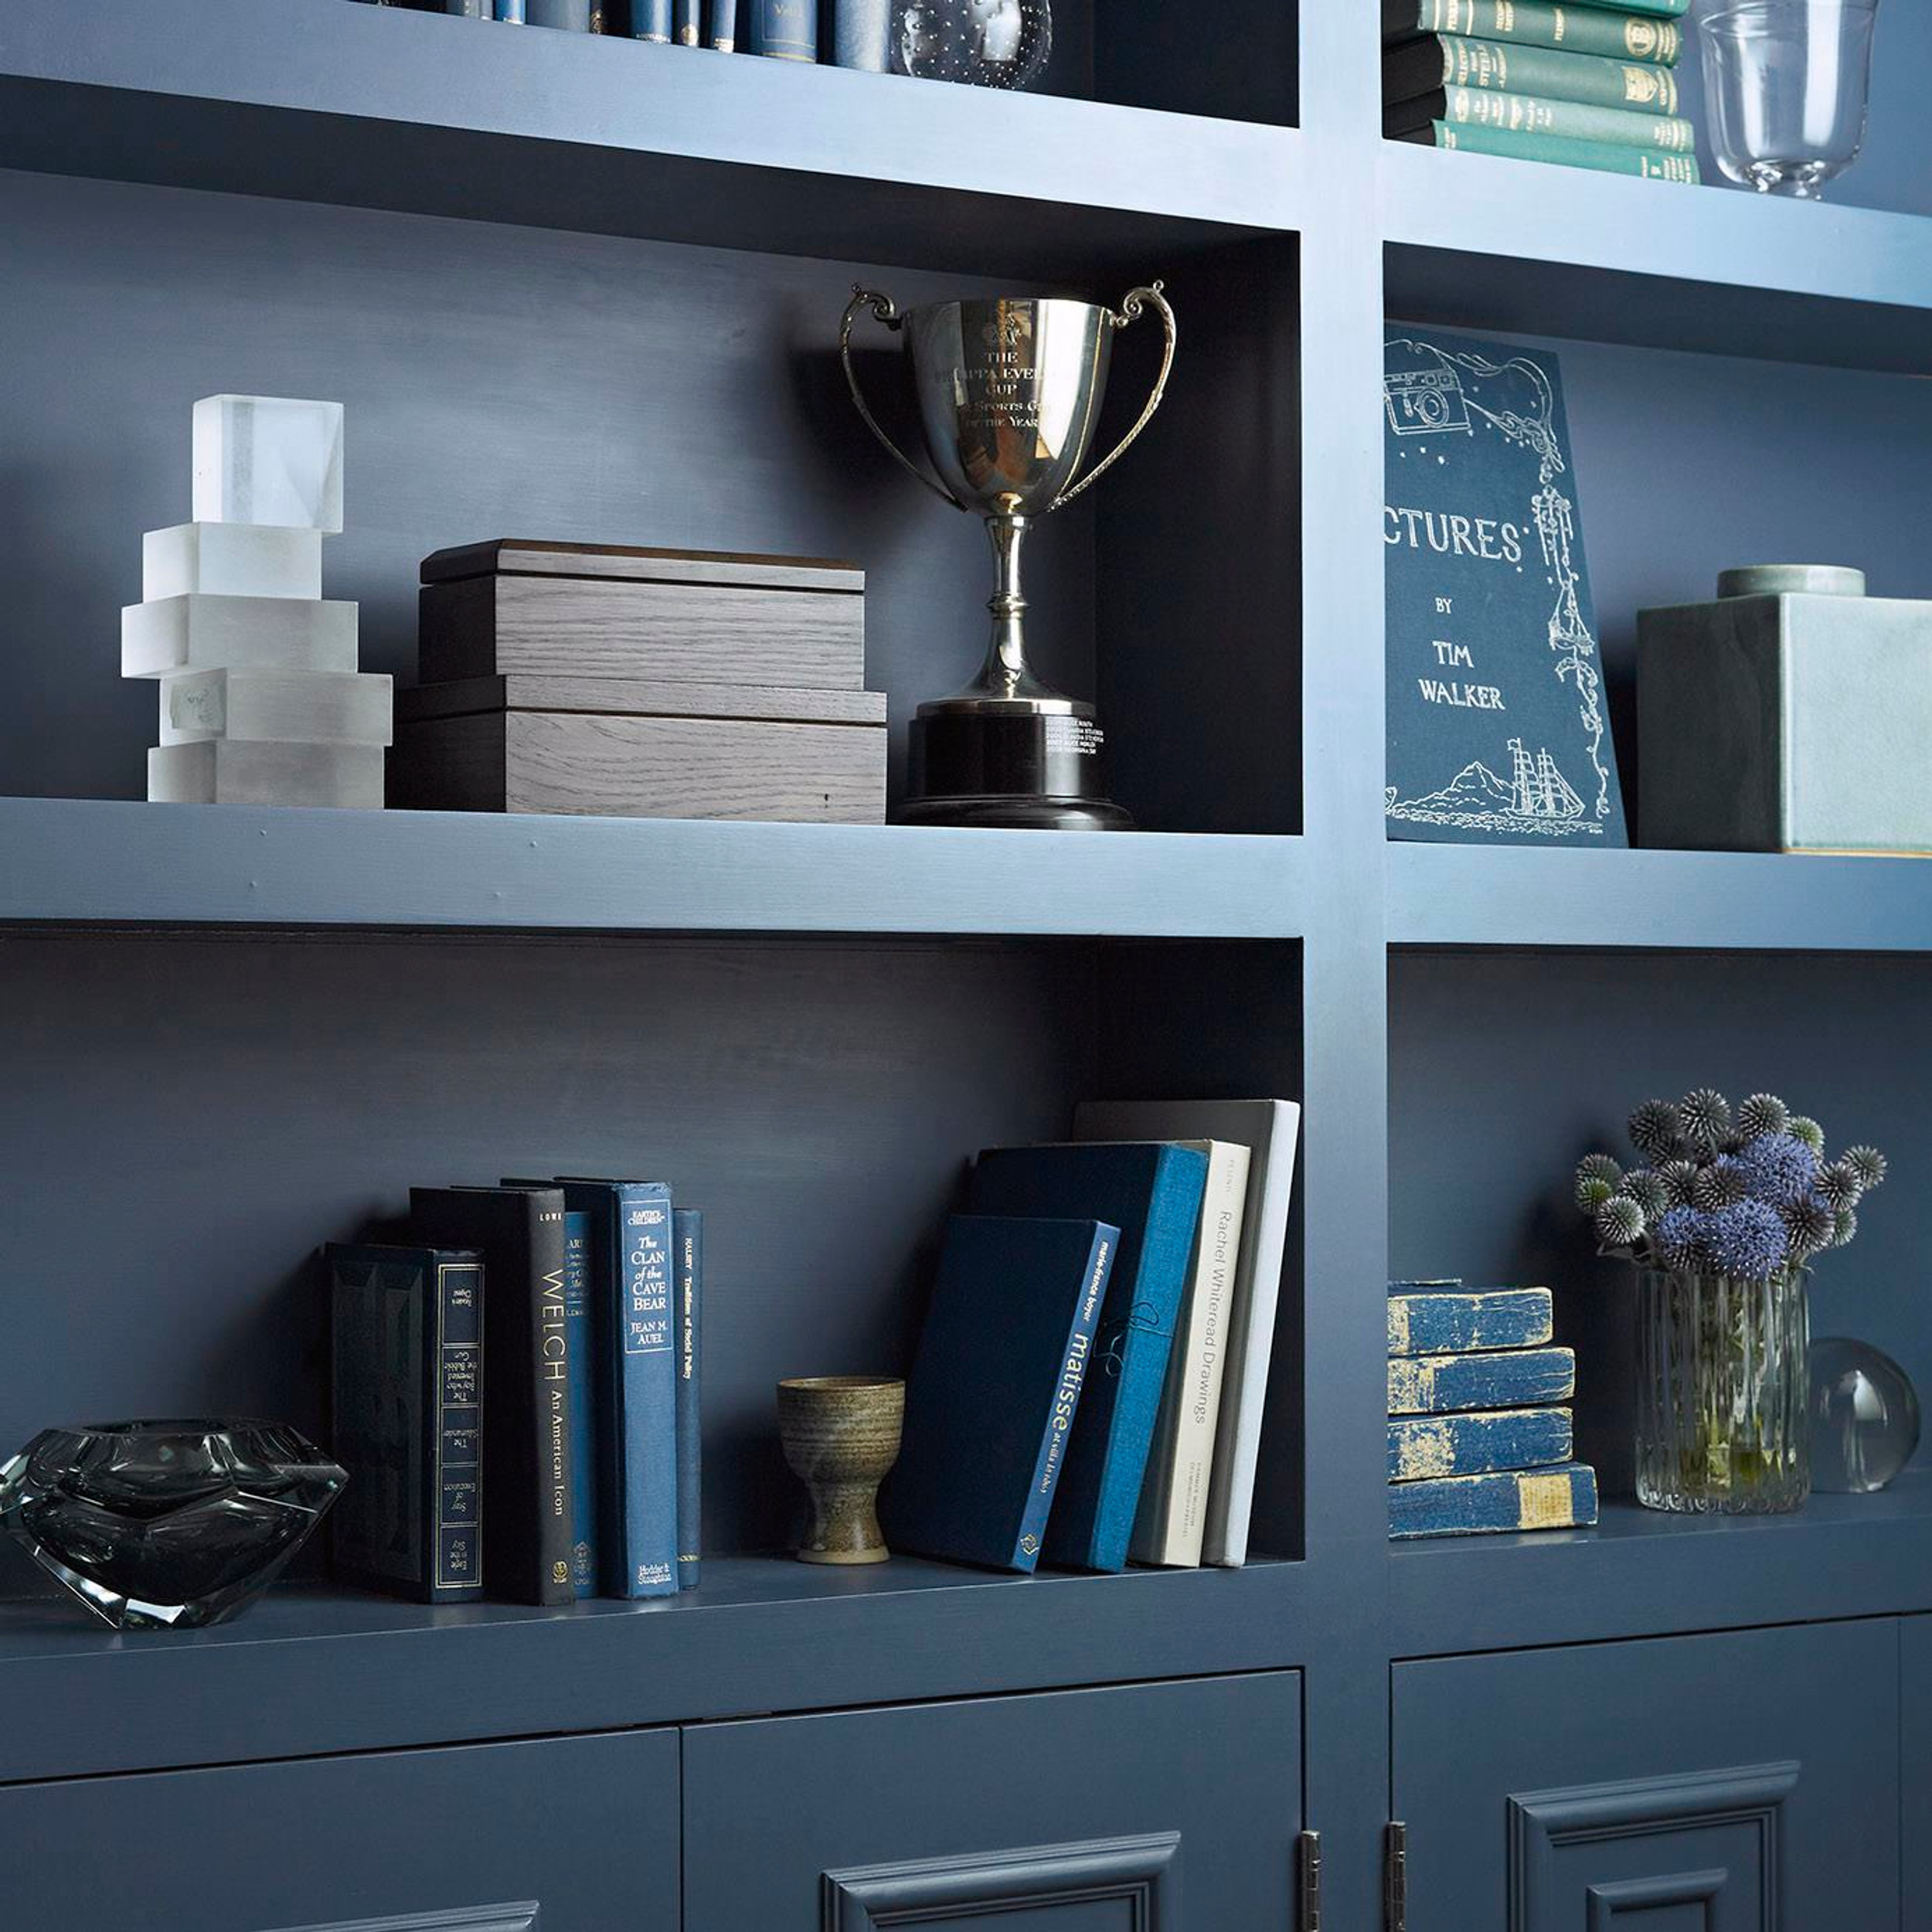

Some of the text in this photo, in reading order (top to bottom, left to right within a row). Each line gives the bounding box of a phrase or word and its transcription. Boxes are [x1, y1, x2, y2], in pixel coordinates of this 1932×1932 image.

[1435, 597, 1453, 614] BY
[1432, 641, 1475, 668] TIM
[1418, 679, 1505, 710] WALKER
[638, 1236, 658, 1249] The
[631, 1251, 665, 1265] CLAN
[634, 1266, 662, 1284] of the
[632, 1282, 666, 1296] CAVE
[633, 1297, 667, 1311] BEAR
[542, 1269, 567, 1380] WELCH
[1194, 1210, 1233, 1425] Rachel Whiteread Drawings
[631, 1322, 656, 1335] JEAN
[637, 1332, 663, 1345] AUEL
[1051, 1332, 1090, 1431] matisse
[453, 1392, 468, 1401] The
[453, 1438, 468, 1447] The
[552, 1390, 565, 1516] An American Icon
